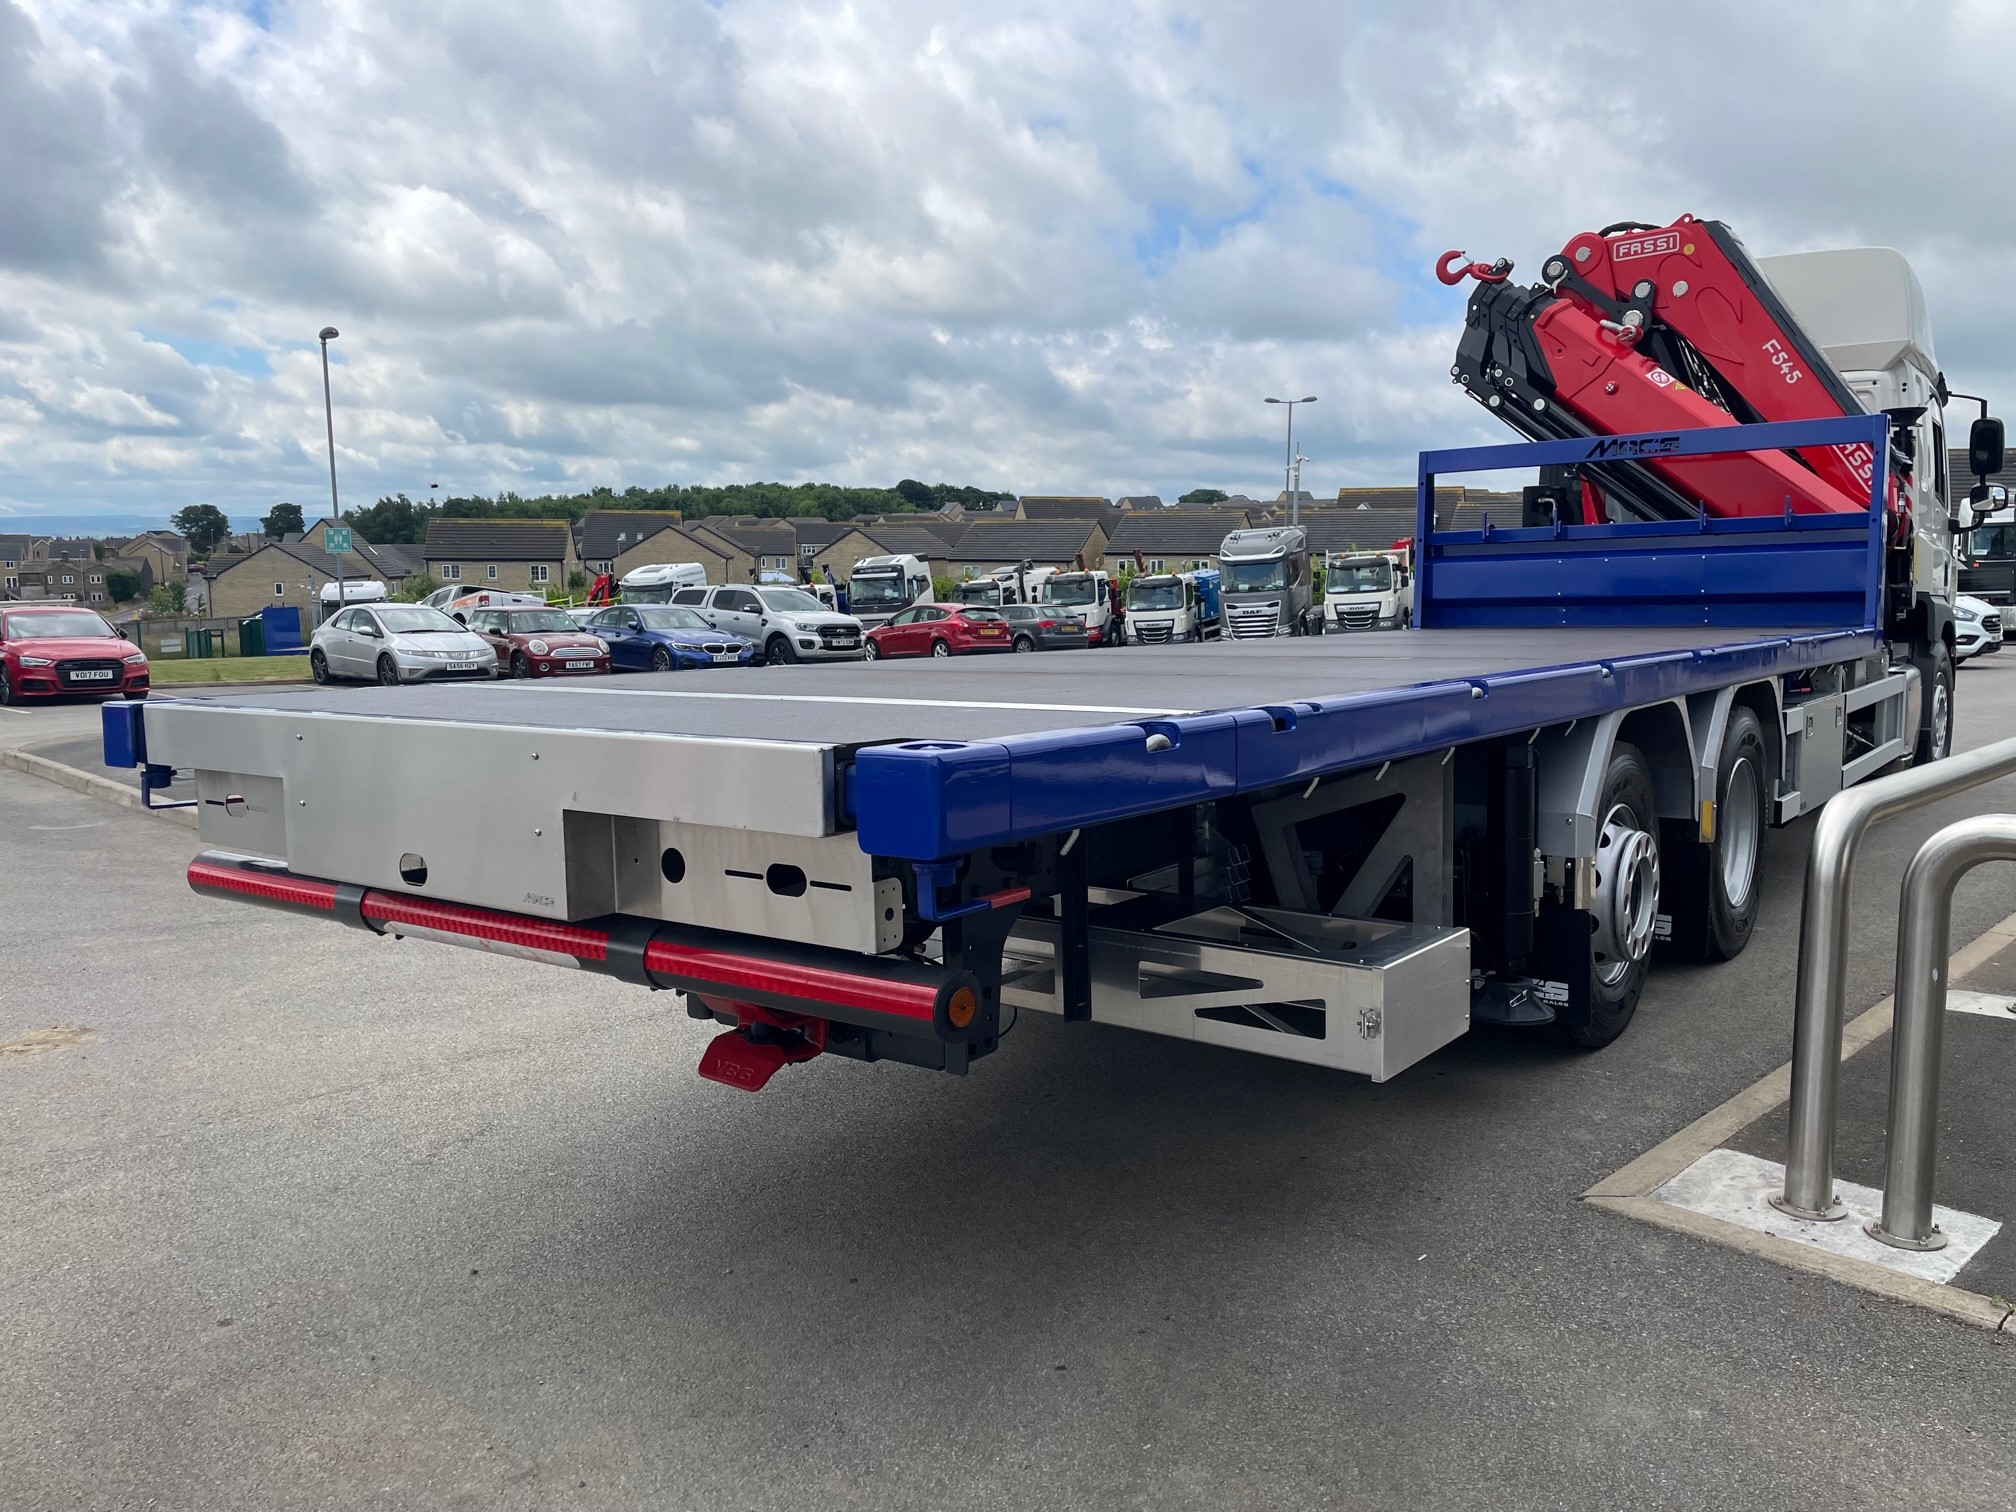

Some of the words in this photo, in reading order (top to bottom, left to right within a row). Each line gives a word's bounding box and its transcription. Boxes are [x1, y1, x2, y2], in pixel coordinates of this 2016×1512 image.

[1620, 237, 1674, 257] FASSI
[1762, 339, 1803, 384] F545
[1839, 443, 1873, 486] ASS
